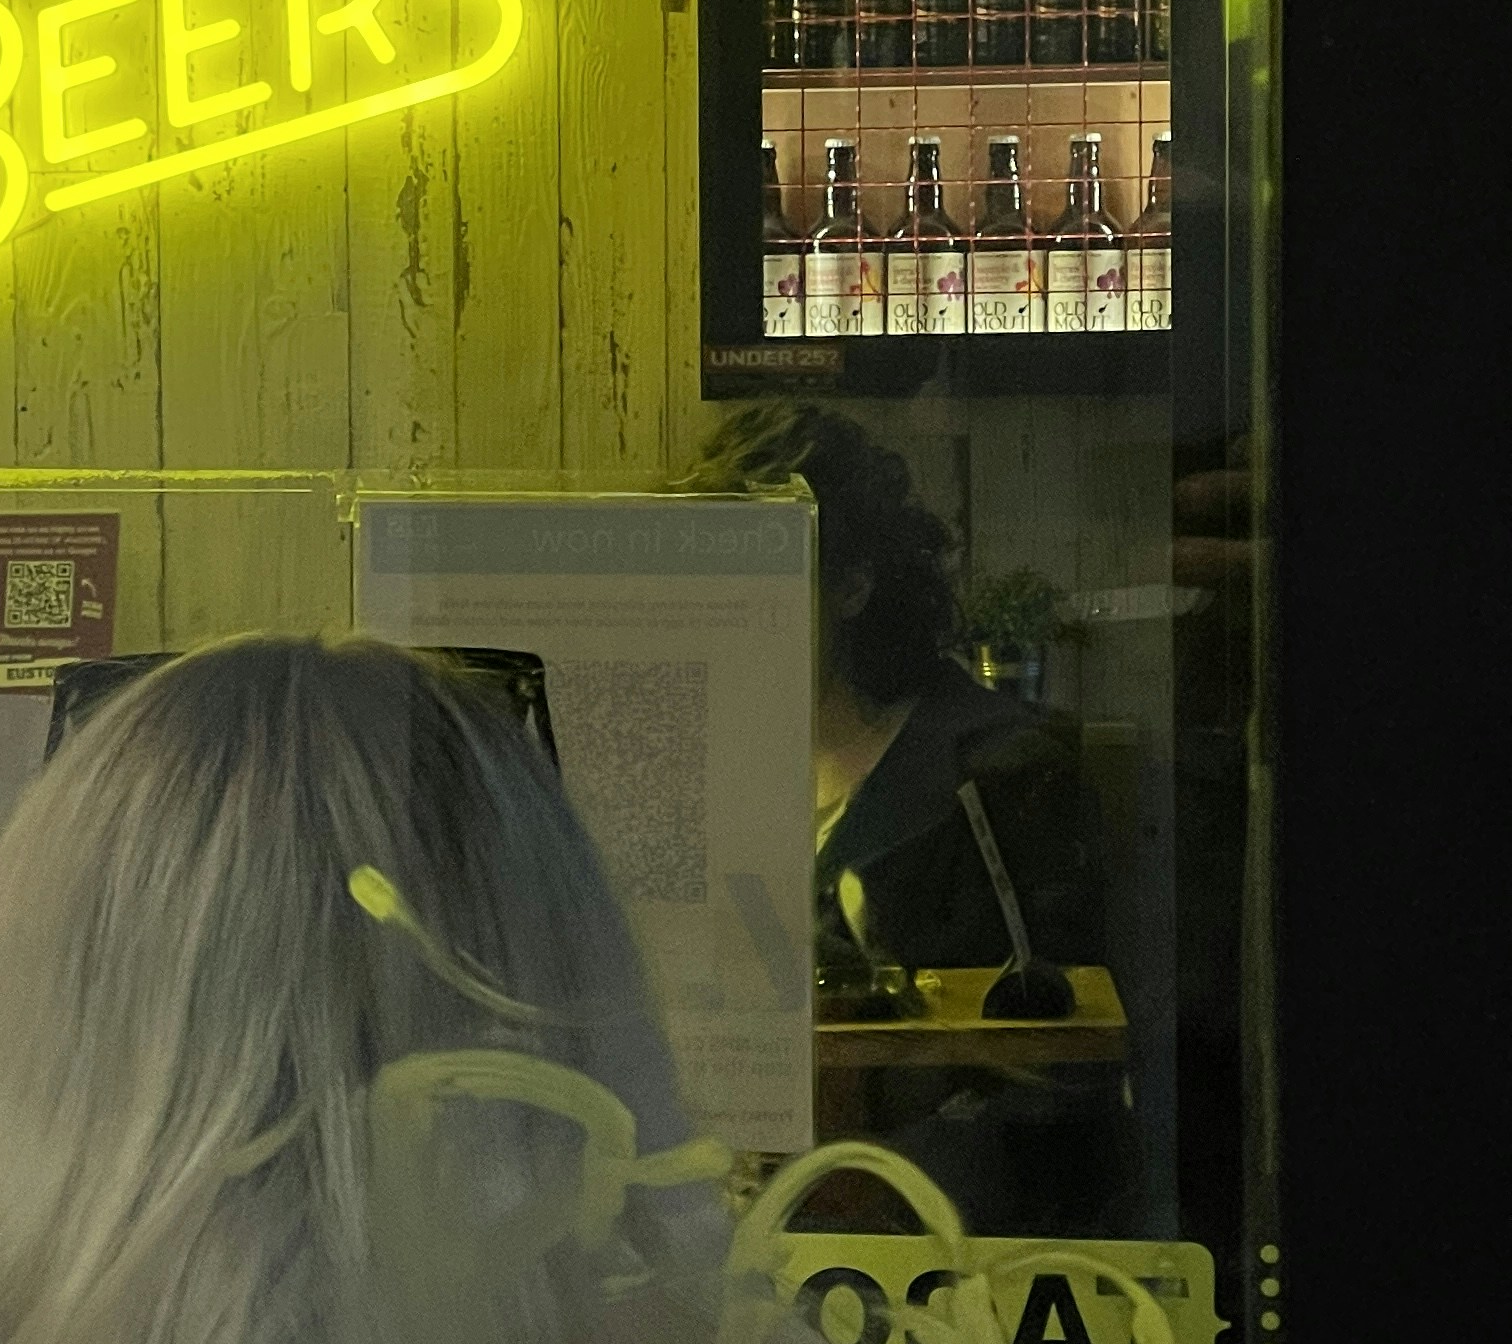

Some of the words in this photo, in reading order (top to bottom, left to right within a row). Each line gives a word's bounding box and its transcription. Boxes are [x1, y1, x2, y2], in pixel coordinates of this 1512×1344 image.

[1132, 314, 1172, 329] MOU
[711, 349, 794, 367] UNDER
[799, 349, 839, 367] 25?
[6, 666, 55, 681] EUSTO
